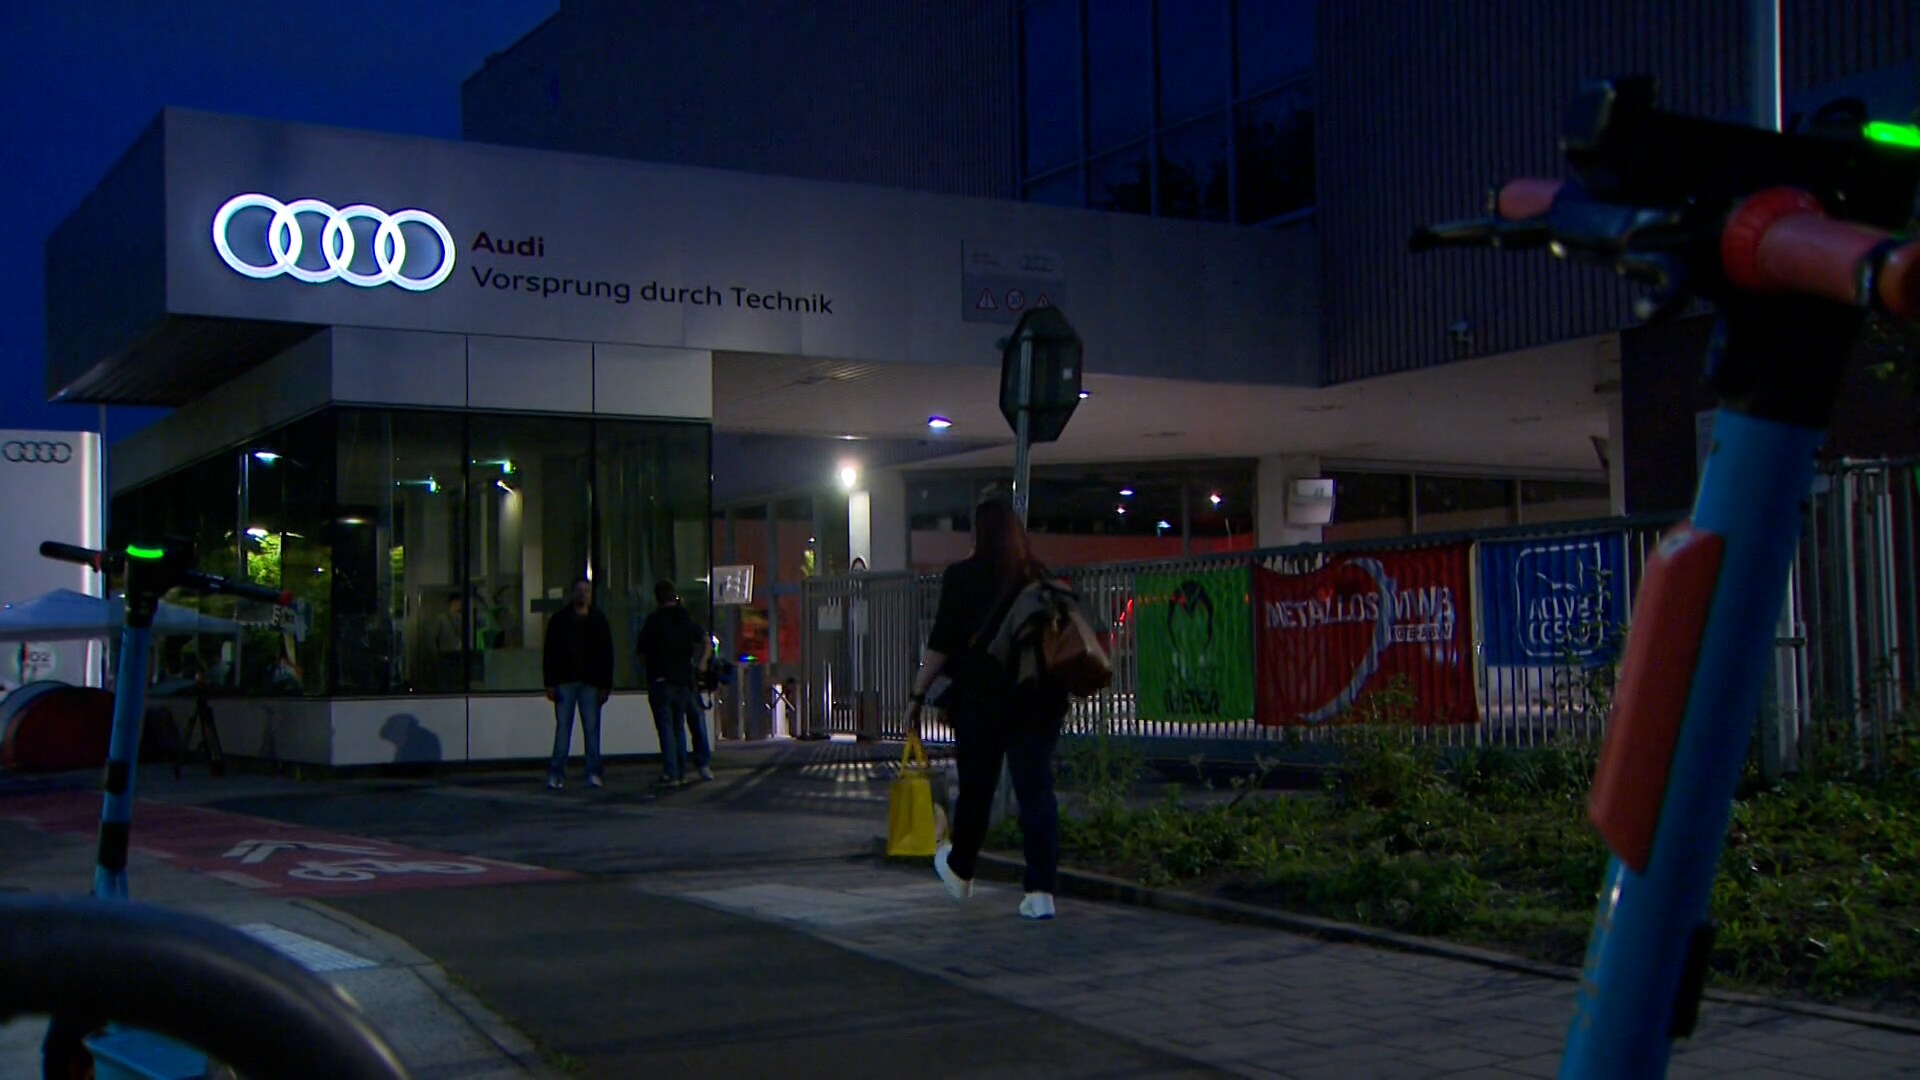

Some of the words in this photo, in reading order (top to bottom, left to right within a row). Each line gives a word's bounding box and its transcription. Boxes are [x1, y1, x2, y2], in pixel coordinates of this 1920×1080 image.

[471, 230, 545, 258] Audi
[471, 265, 631, 304] Vorsprung
[640, 280, 722, 307] durch
[729, 286, 833, 315] Technik
[1265, 592, 1380, 629] METALLOS
